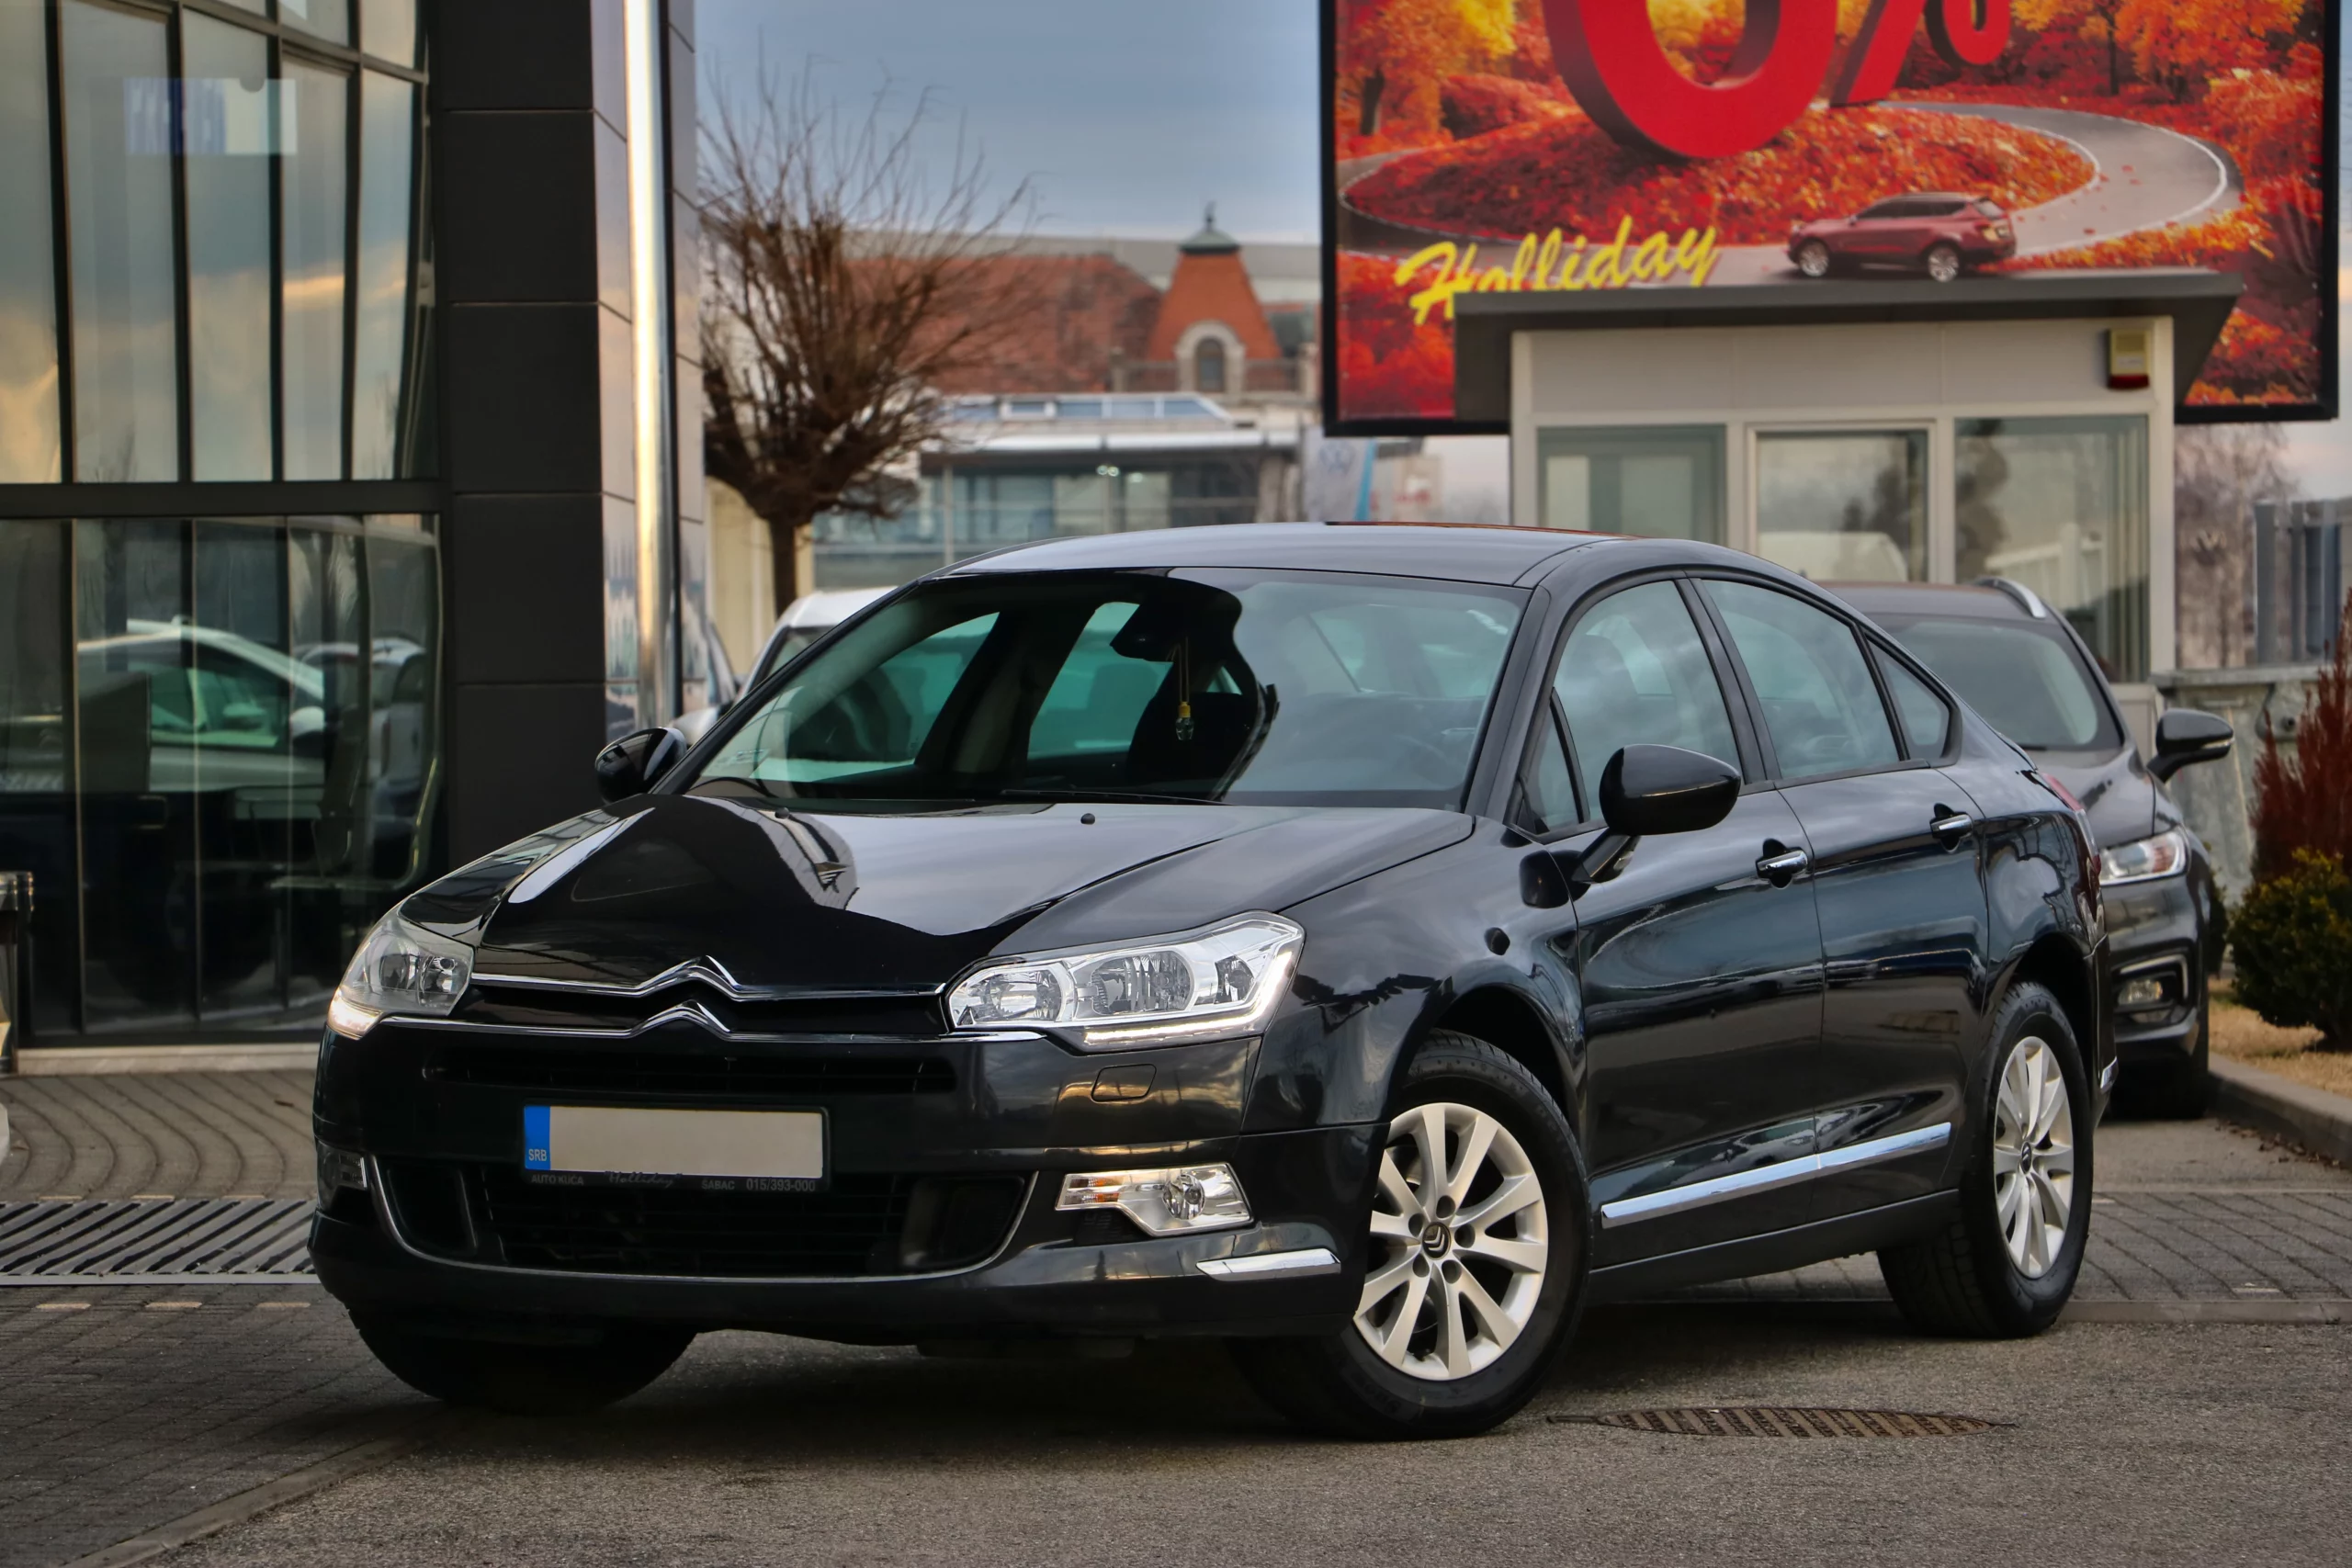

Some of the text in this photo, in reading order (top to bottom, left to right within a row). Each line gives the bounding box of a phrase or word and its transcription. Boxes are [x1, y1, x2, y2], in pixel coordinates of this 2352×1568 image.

[528, 1148, 548, 1162] SRB
[531, 1173, 557, 1185] AUTO
[745, 1178, 816, 1192] 015/393-000
